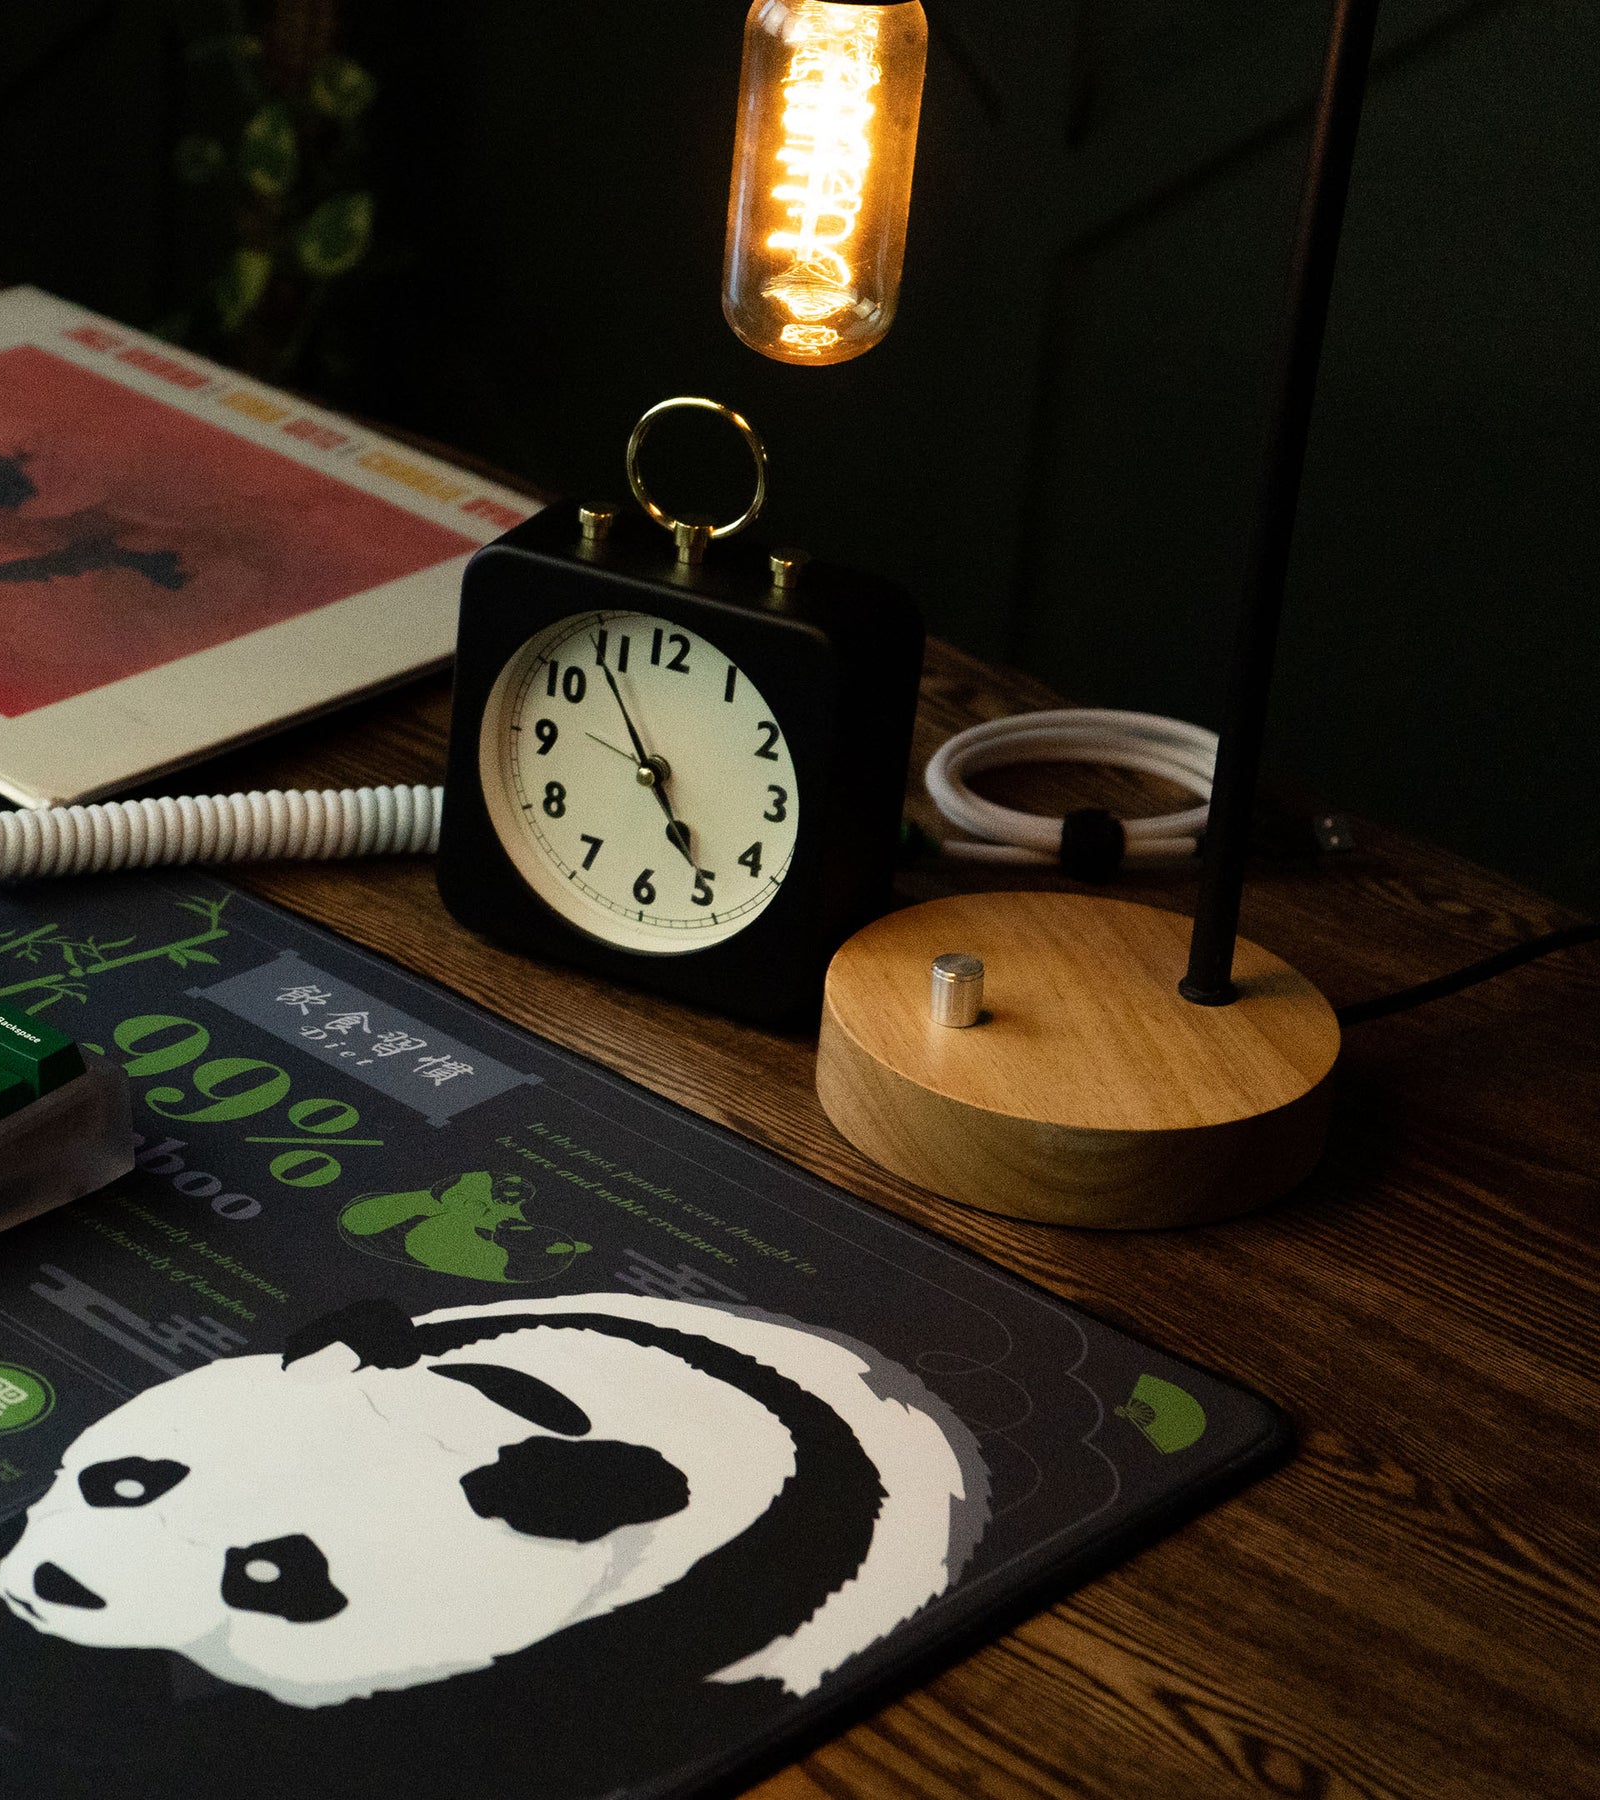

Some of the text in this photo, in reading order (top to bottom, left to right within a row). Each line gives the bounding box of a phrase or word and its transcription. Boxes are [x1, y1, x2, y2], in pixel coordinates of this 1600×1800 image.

[595, 629, 630, 672] 11
[650, 628, 690, 673] 12
[547, 661, 586, 703] 10
[724, 665, 737, 703] 1
[535, 718, 558, 755] 9
[755, 721, 779, 760] 2
[543, 781, 566, 818] 8
[764, 784, 787, 822] 3
[580, 834, 603, 869] 7
[738, 842, 762, 876] 4
[633, 868, 656, 905] 6
[691, 869, 716, 906] 5
[275, 984, 476, 1088] 飲食習慣
[300, 1025, 375, 1067] Diet
[113, 1014, 384, 1188] 99%
[515, 1147, 558, 1169] rare
[554, 1168, 603, 1190] and
[594, 1188, 650, 1216] noble
[525, 1121, 551, 1136] In
[546, 1134, 580, 1150] the
[610, 1169, 685, 1204] pandas
[680, 1203, 727, 1227] were
[722, 1225, 800, 1264] thought
[793, 1262, 820, 1275] to
